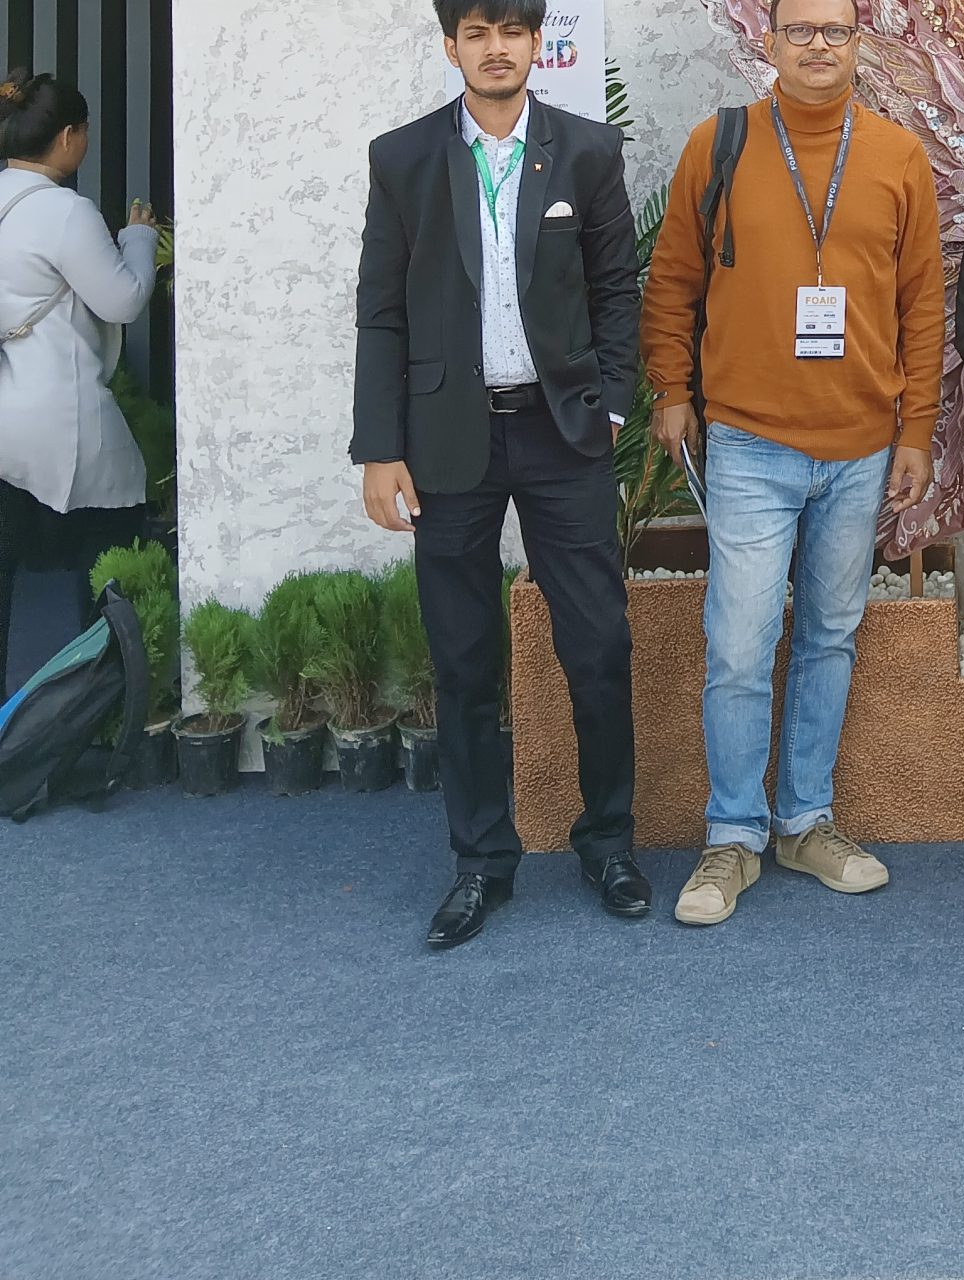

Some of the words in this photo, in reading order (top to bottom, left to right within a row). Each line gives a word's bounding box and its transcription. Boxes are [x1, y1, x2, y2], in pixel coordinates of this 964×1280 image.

[542, 10, 580, 38] ting
[826, 182, 838, 208] FOAID
[804, 296, 838, 305] FOAID
